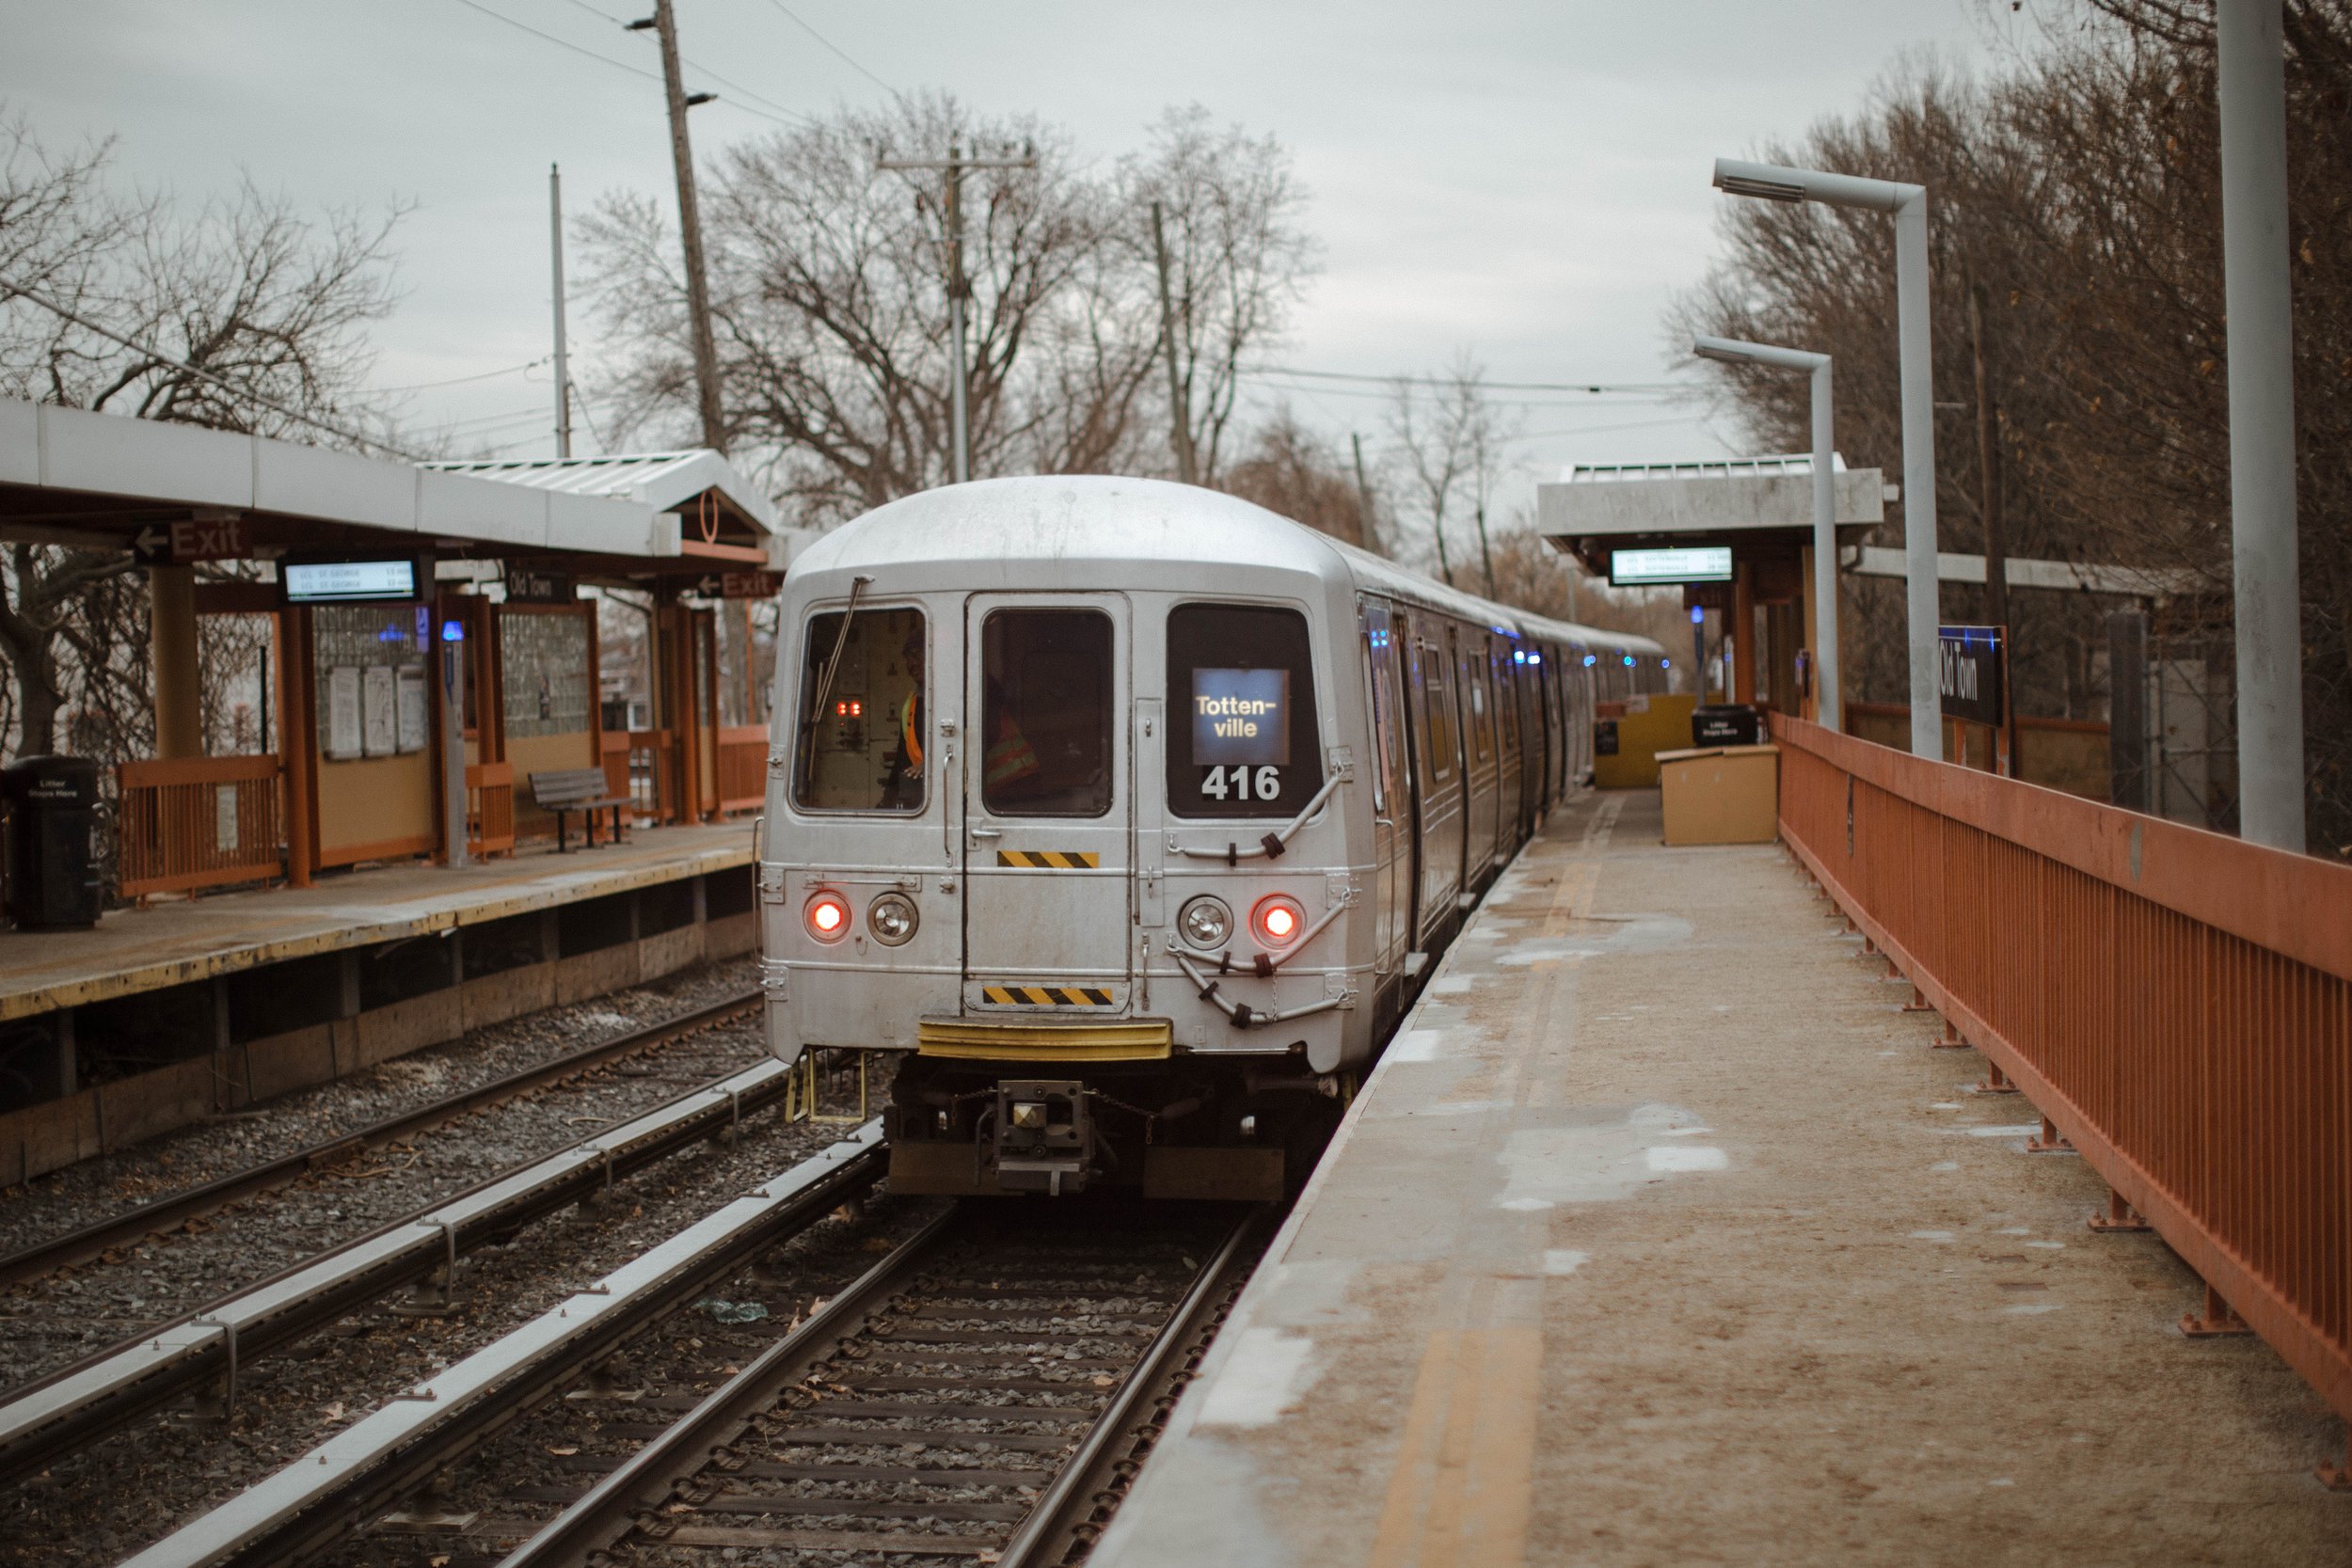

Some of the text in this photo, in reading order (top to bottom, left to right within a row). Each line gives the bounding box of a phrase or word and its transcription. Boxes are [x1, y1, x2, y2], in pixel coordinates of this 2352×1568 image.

[171, 521, 242, 556] Exit
[723, 573, 771, 595] Exit
[1939, 640, 1978, 702] Old Town
[1196, 696, 1277, 716] Totten-
[1214, 719, 1258, 737] ville
[1201, 766, 1280, 800] 416
